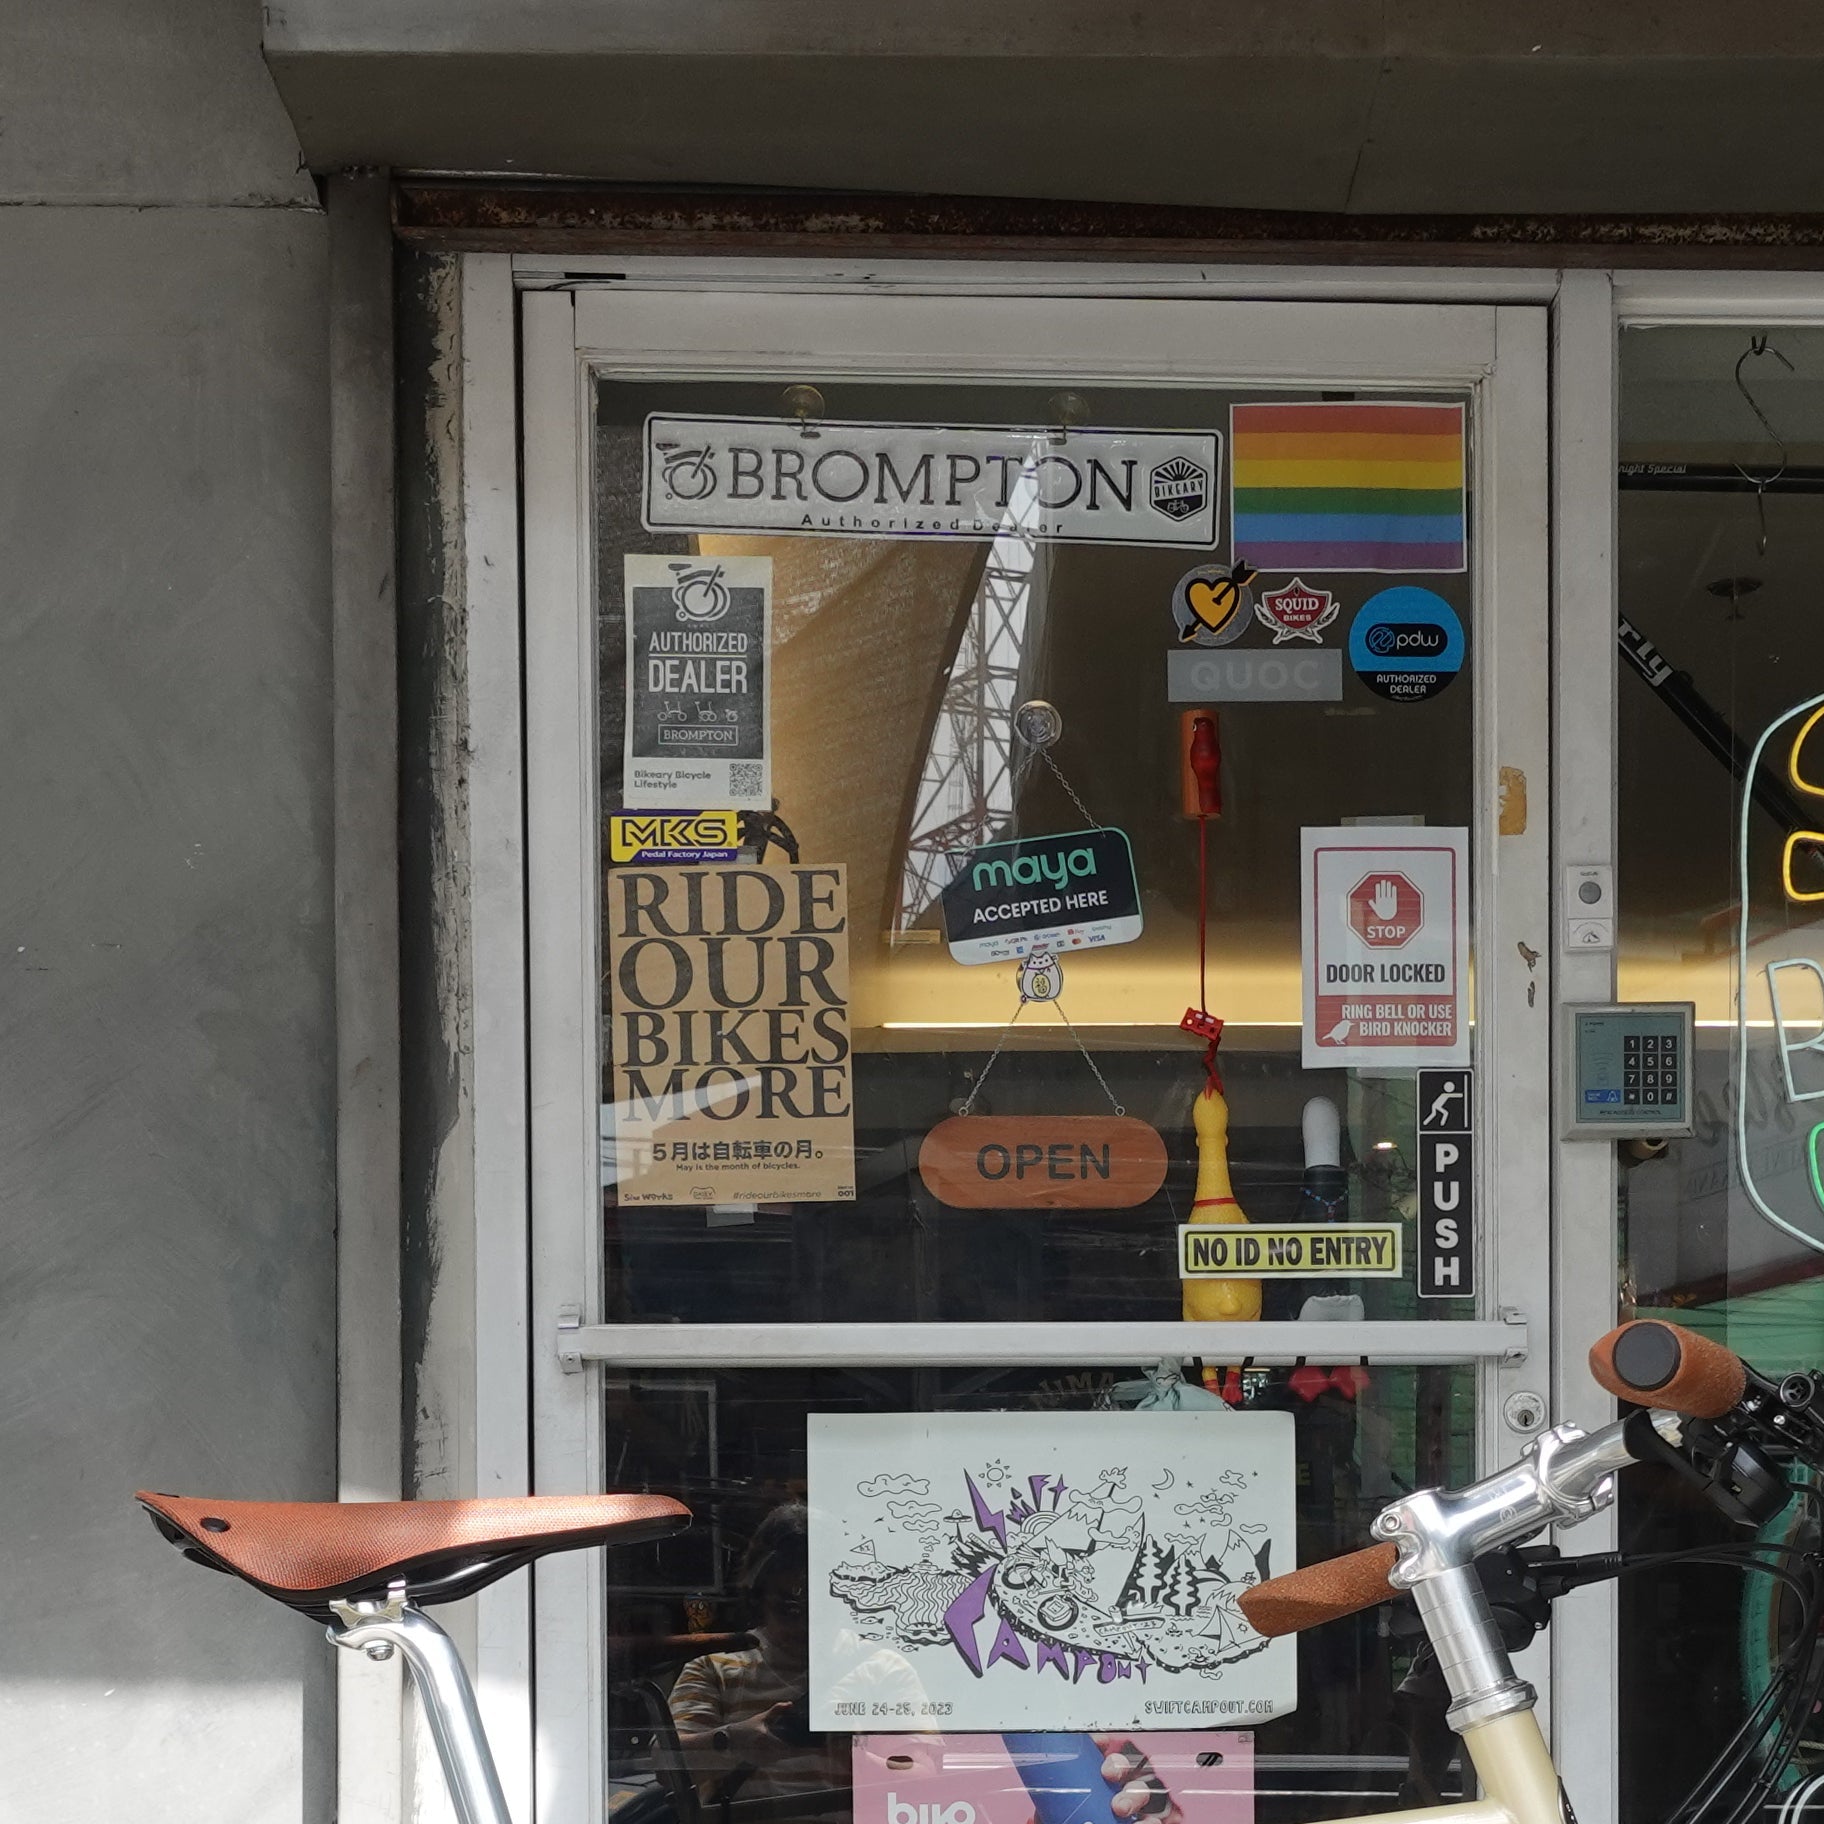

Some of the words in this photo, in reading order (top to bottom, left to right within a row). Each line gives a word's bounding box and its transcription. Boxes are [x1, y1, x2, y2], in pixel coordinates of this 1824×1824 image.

[728, 447, 1137, 512] BROMPTON
[1154, 478, 1204, 500] BIKEARY
[801, 513, 960, 531] Authorized
[1275, 597, 1319, 612] SQUID
[1283, 614, 1312, 622] BIKES
[649, 632, 748, 653] AUTHORIZED
[1396, 630, 1439, 649] pdw
[648, 659, 748, 693] DEALER
[1191, 660, 1321, 692] QUOC
[1376, 674, 1437, 684] AUTHORIZED
[1389, 684, 1427, 694] DEALER
[663, 729, 733, 742] BROMPTON
[634, 770, 672, 780] Bikeary
[675, 770, 711, 780] Bicycle
[634, 780, 677, 790] Lifestyle
[622, 818, 728, 848] MKS
[641, 849, 666, 859] Pedal
[668, 849, 700, 860] Factory
[702, 849, 728, 859] Japan
[972, 848, 1097, 891] maya
[617, 869, 846, 938] RIDE
[973, 897, 1061, 924] ACCEPTED
[1066, 889, 1109, 910] HERE
[1366, 925, 1406, 939] STOP
[619, 935, 848, 1010] OUR
[1326, 963, 1375, 983] DOOR
[1380, 963, 1446, 983] LOCKED
[1342, 1004, 1372, 1019] RING
[1376, 1004, 1405, 1018] BELL
[1408, 1004, 1426, 1018] OR
[1428, 1004, 1453, 1018] USE
[1359, 1021, 1391, 1036] BIRD
[1394, 1021, 1452, 1036] KNOCKER
[621, 1007, 850, 1068] BIKES
[1647, 1039, 1654, 1049] 2
[1665, 1039, 1672, 1049] 3
[1647, 1057, 1654, 1066] 5
[1665, 1057, 1672, 1066] 6
[1628, 1074, 1635, 1083] 7
[1647, 1074, 1654, 1084] 8
[1665, 1074, 1672, 1083] 9
[622, 1065, 851, 1123] MORE
[1647, 1092, 1654, 1101] 0
[652, 1139, 824, 1162] 5月は自転車の月。
[676, 1164, 694, 1173] May
[705, 1163, 719, 1171] the
[752, 1162, 761, 1170] of
[763, 1162, 800, 1172] bicycles.
[977, 1143, 1110, 1181] OPEN
[733, 1190, 821, 1200] #rideourbikesmore
[838, 1188, 854, 1197] 001
[1433, 1143, 1461, 1287] PUSH
[1193, 1238, 1227, 1267] NO
[1236, 1237, 1258, 1266] ID
[1261, 1237, 1303, 1266] NO
[1310, 1236, 1389, 1265] ENTRY
[943, 1563, 1153, 1685] CAMPOUT
[834, 1702, 866, 1716] JUNE
[872, 1702, 915, 1717] 24-25,
[921, 1701, 954, 1716] 2023
[1144, 1699, 1274, 1715] SWIFTCAMPOUT.COM
